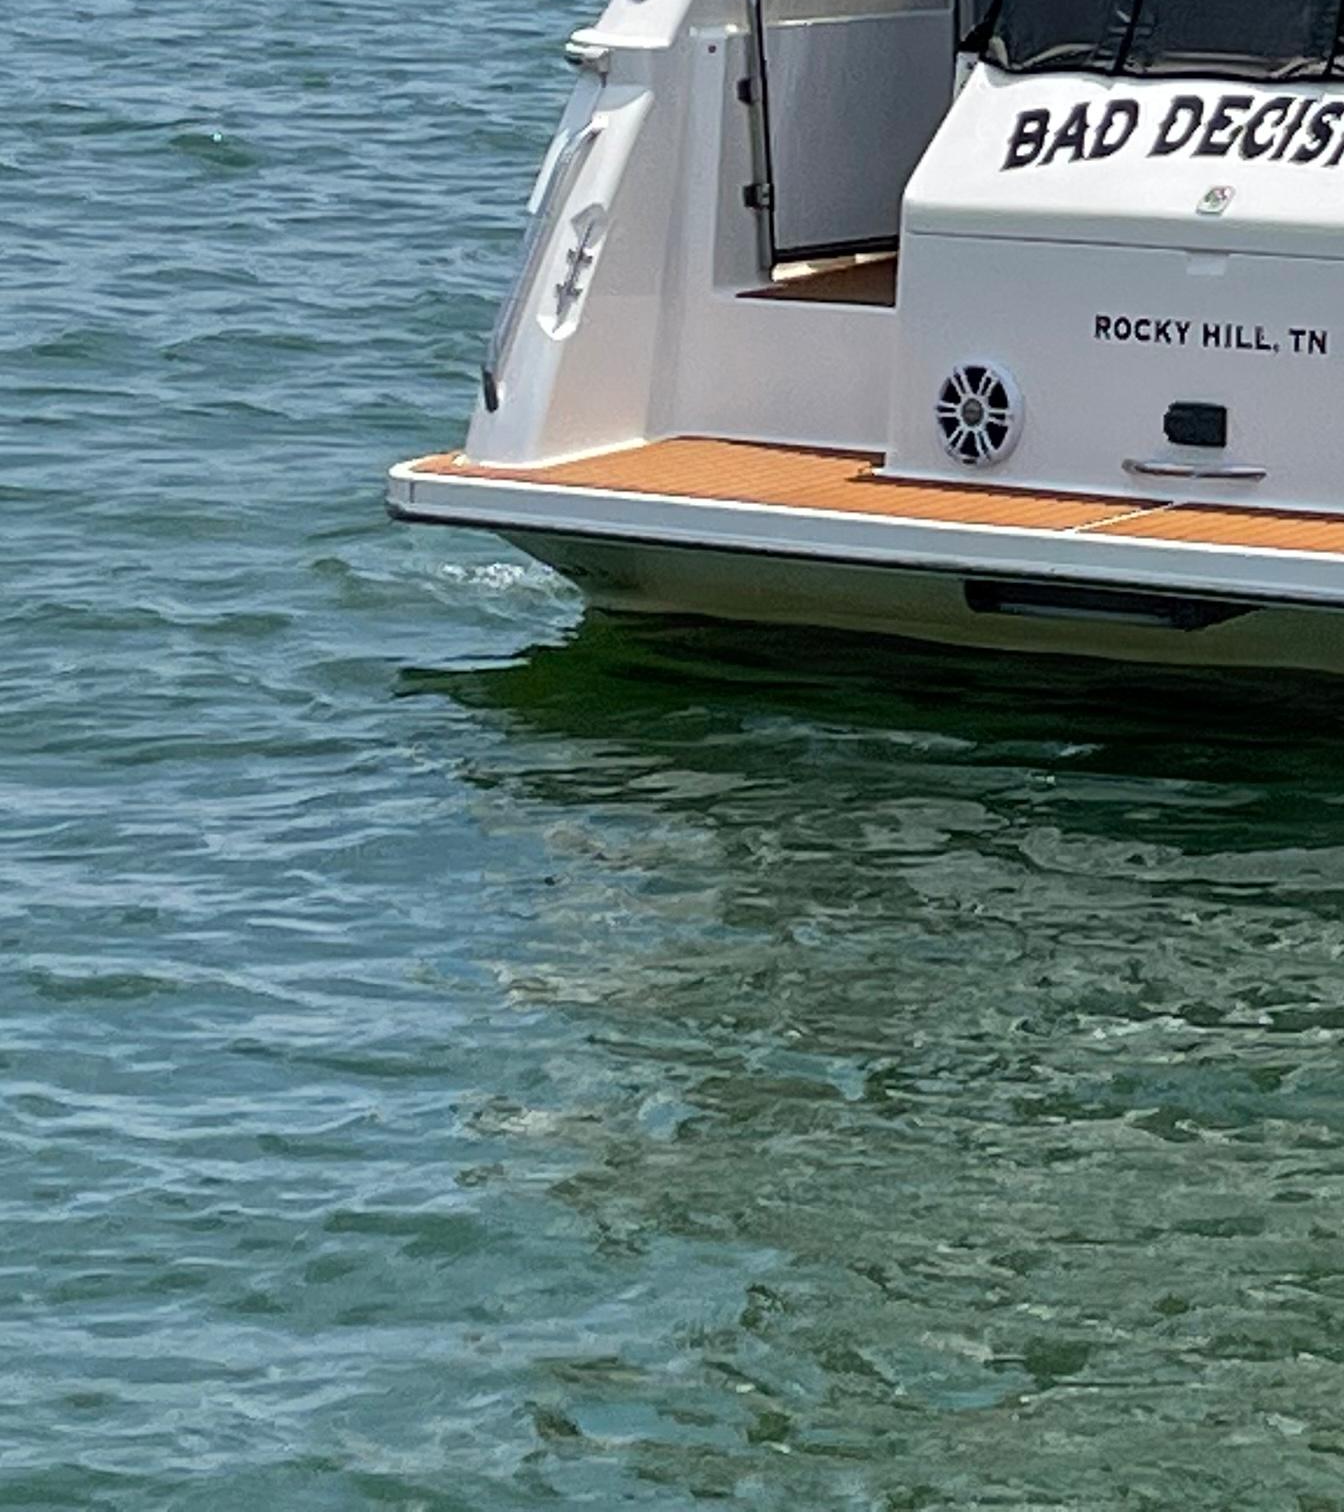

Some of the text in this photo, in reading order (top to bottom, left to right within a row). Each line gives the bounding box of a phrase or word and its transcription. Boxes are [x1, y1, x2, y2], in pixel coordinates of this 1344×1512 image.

[1001, 98, 1140, 171] BAD
[1094, 315, 1328, 355] ROCKY HILL, TN
